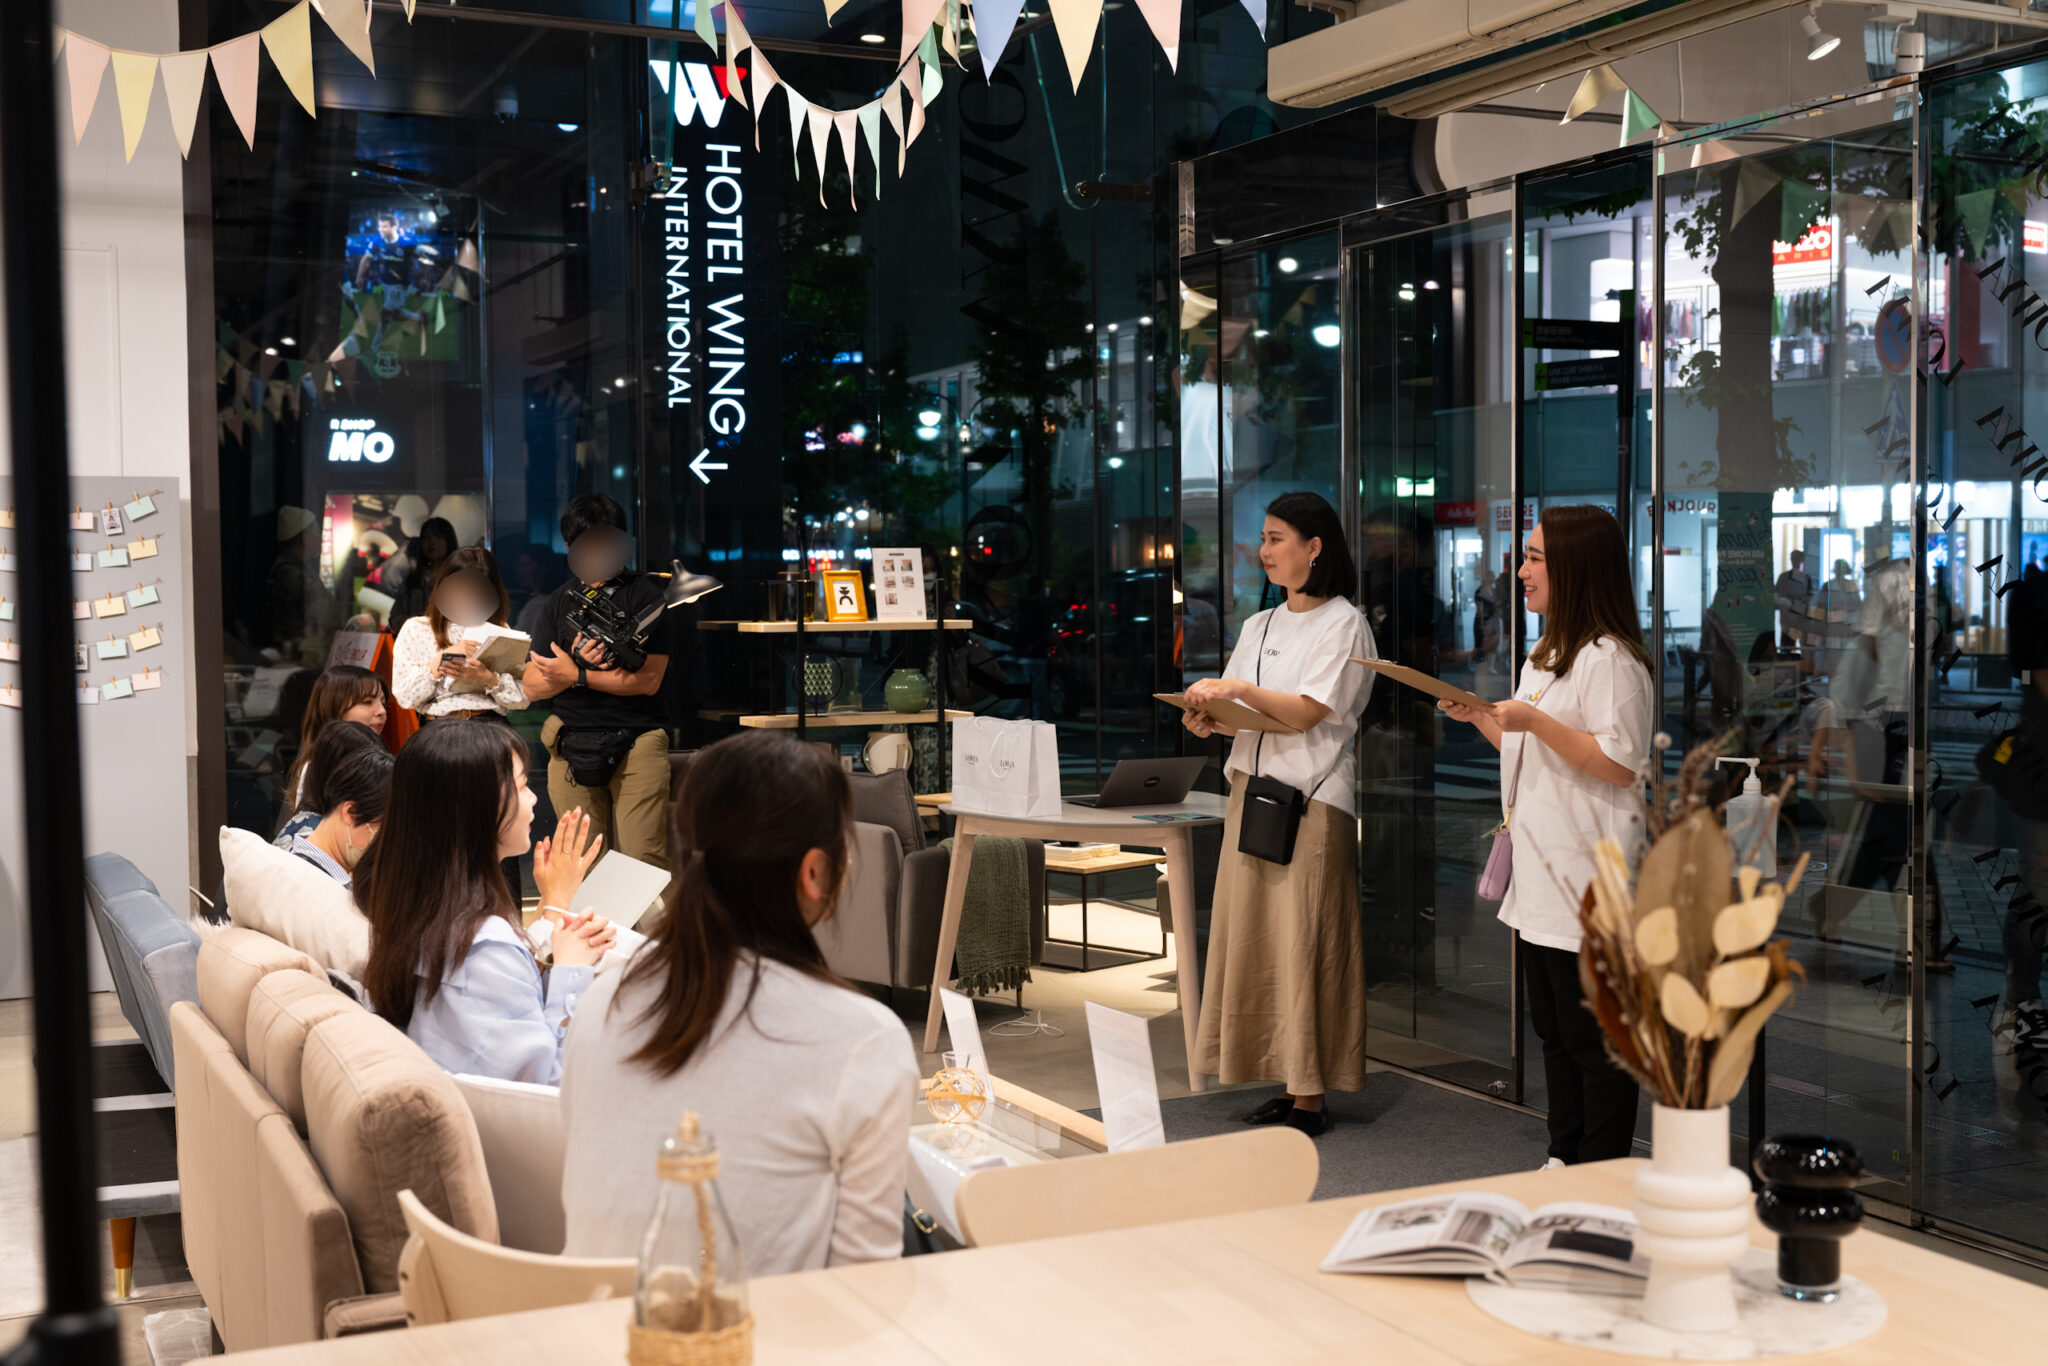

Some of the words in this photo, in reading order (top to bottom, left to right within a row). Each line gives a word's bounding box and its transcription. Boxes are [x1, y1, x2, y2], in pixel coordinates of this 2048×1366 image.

[704, 143, 744, 283] HOTEL
[664, 166, 692, 409] INTERNATIONAL
[706, 293, 746, 435] WING
[1647, 499, 1717, 517] BNJOUR
